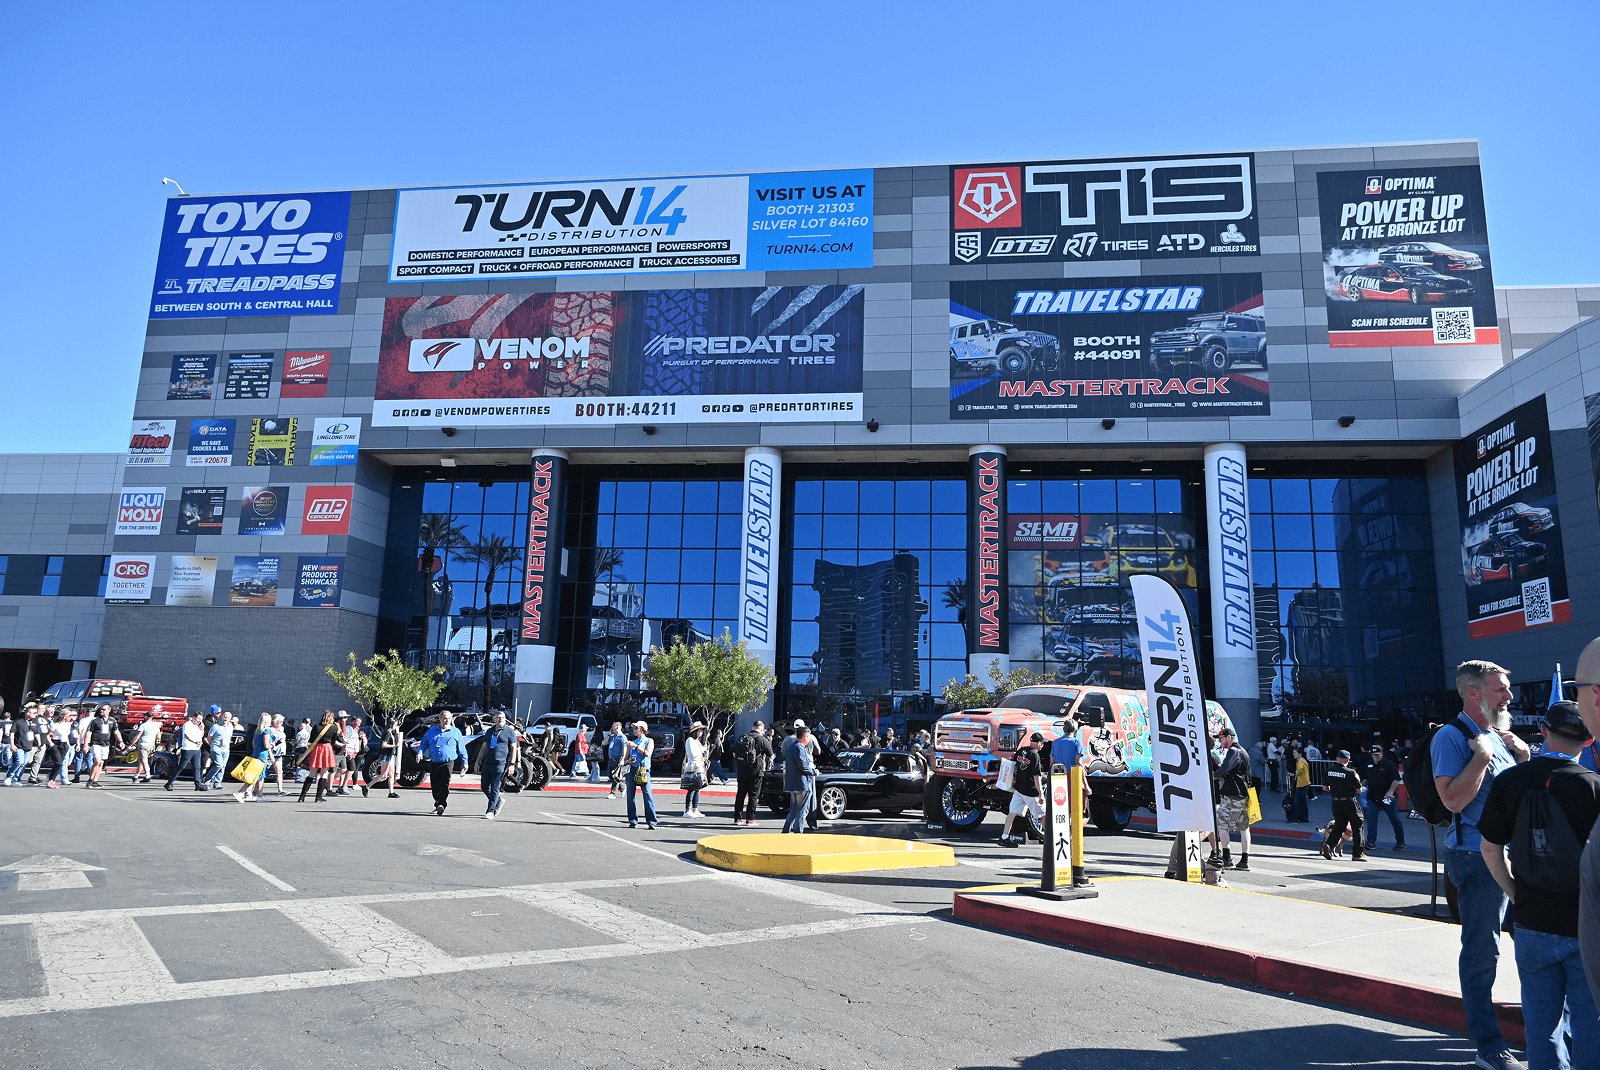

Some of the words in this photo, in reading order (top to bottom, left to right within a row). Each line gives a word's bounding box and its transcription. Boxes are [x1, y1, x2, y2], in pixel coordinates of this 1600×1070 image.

[1384, 176, 1434, 190] OPTIMA
[756, 188, 806, 202] VISIT
[812, 186, 837, 199] US
[841, 185, 866, 198] AT
[177, 199, 312, 234] TOYO
[454, 185, 688, 236] TURN14
[766, 205, 814, 216] BOOTH
[817, 203, 854, 214] 21303
[1340, 198, 1425, 226] POWER
[1430, 194, 1464, 220] UP
[752, 220, 797, 230] SILVER
[801, 218, 827, 228] LOT
[829, 217, 868, 227] 84160
[1342, 227, 1358, 240] AT
[1361, 225, 1385, 239] THE
[1388, 220, 1439, 237] BRONZE
[1440, 218, 1465, 234] LOT
[528, 228, 663, 241] DISTRIBUTION
[184, 232, 334, 267] TIRES
[531, 246, 580, 256] EUROPEAN
[582, 244, 650, 254] PERFORMANCE
[659, 242, 728, 251] POWERSPORTS
[767, 242, 854, 254] TURN14.COM
[993, 238, 1051, 254] DTS
[1101, 240, 1148, 251] TIRES
[1156, 234, 1205, 252] ATD
[410, 252, 454, 260] DOMESTIC
[457, 249, 522, 258] PERFORMANCE
[642, 258, 672, 266] TRUCK
[674, 256, 738, 265] ACCESSORIES
[399, 266, 427, 275] SPORT
[430, 265, 472, 274] COMPACT
[482, 264, 510, 272] TRUCK
[520, 262, 562, 270] OFFROAD
[564, 259, 632, 269] PERFORMANCE
[186, 274, 337, 293] TREADPASS
[1350, 276, 1380, 290] OPTIMA
[155, 304, 204, 312] BETWEEN
[206, 302, 242, 311] SOUTH
[255, 301, 303, 310] CENTRAL
[306, 300, 333, 308] HALL
[1011, 286, 1204, 315] TRAVELSTAR
[1352, 319, 1372, 327] SCAN
[1373, 318, 1388, 326] FOR
[1389, 317, 1428, 326] SCHEDULE
[478, 336, 590, 359] VENOM
[662, 334, 836, 356] PREDATOR
[1074, 336, 1140, 346] BOOTH
[289, 354, 326, 368] Milwaukee
[788, 356, 836, 365] TIRES
[1074, 350, 1140, 360] #44091
[478, 360, 590, 370] POWER
[999, 378, 1230, 397] MASTERTRACK
[435, 406, 550, 417] @VENOMPOWERTIRES
[576, 402, 676, 417] BOOTH:44211
[750, 402, 853, 413] @PREDATORTIRES
[247, 419, 258, 466] CARLYLE
[288, 418, 298, 465] CARLYLE
[1486, 422, 1515, 450] OPTIMA
[1466, 450, 1511, 501] POWER
[1514, 436, 1536, 474] UP
[1469, 499, 1477, 517] AT
[1478, 493, 1490, 514] THE
[1492, 477, 1520, 508] BRONZE
[1521, 466, 1538, 489] LOT
[122, 494, 162, 507] LIQUI
[120, 509, 161, 522] MOLY
[1016, 522, 1078, 537] SEMA
[522, 460, 552, 639] MASTERTRACK
[744, 459, 773, 644] TRAVELSTAR
[979, 458, 999, 646] MASTERTRACK
[1217, 456, 1253, 651] TRAVELSTAR
[116, 564, 146, 575] CRC
[1479, 603, 1490, 614] SCAN
[1499, 595, 1521, 609] SCHEDULE
[1176, 626, 1198, 740] DISTRIBUTION
[1144, 610, 1193, 810] TURN14
[1054, 792, 1065, 801] STOP
[1056, 815, 1066, 824] FOR
